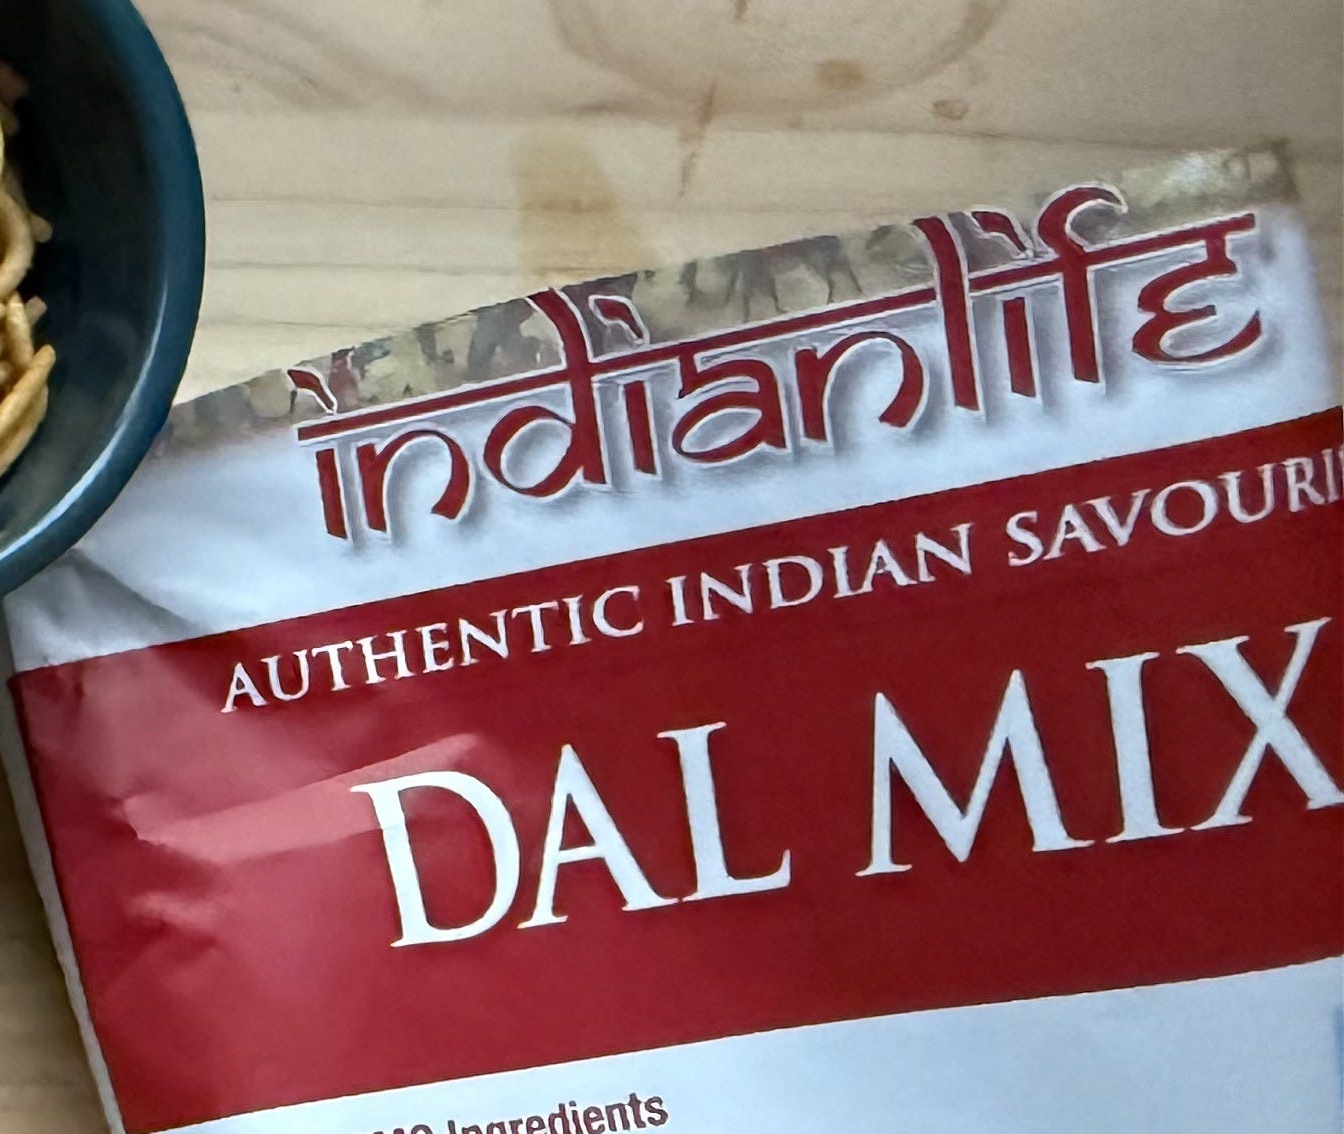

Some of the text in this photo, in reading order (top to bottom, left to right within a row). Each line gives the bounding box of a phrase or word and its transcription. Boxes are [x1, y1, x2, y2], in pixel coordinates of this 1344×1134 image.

[291, 181, 1263, 541] indianlife
[222, 444, 1344, 713] AUTHENTIC INDIAN SAVOURI
[350, 616, 1344, 948] DAL MIX
